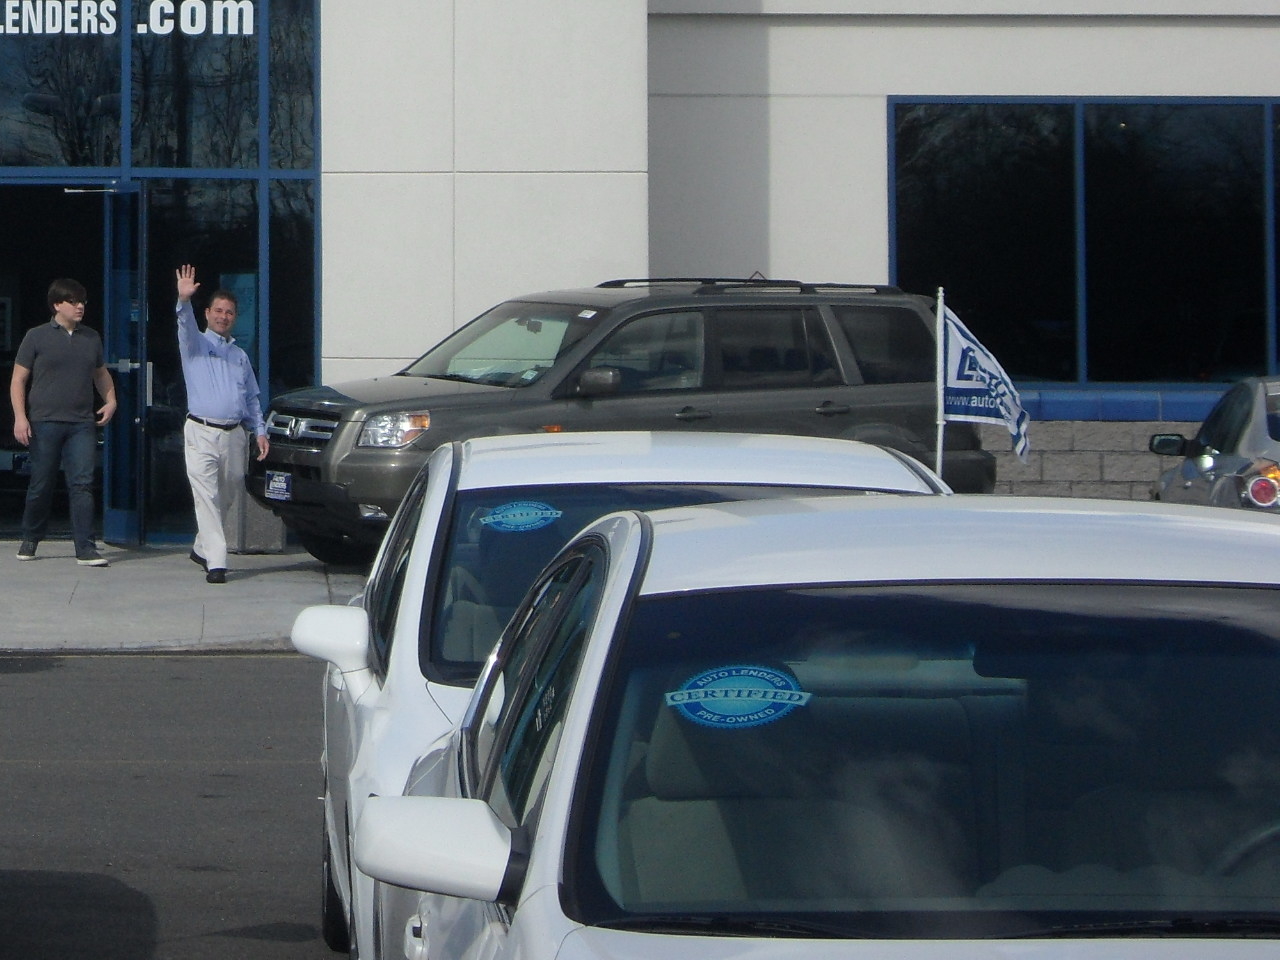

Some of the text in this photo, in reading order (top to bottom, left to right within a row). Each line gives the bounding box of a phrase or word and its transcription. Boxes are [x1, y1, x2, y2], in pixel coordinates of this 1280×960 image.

[696, 669, 786, 687] AUTO LENDERS
[670, 689, 804, 703] CERTIFIED
[696, 708, 776, 724] PRE-OWNED
